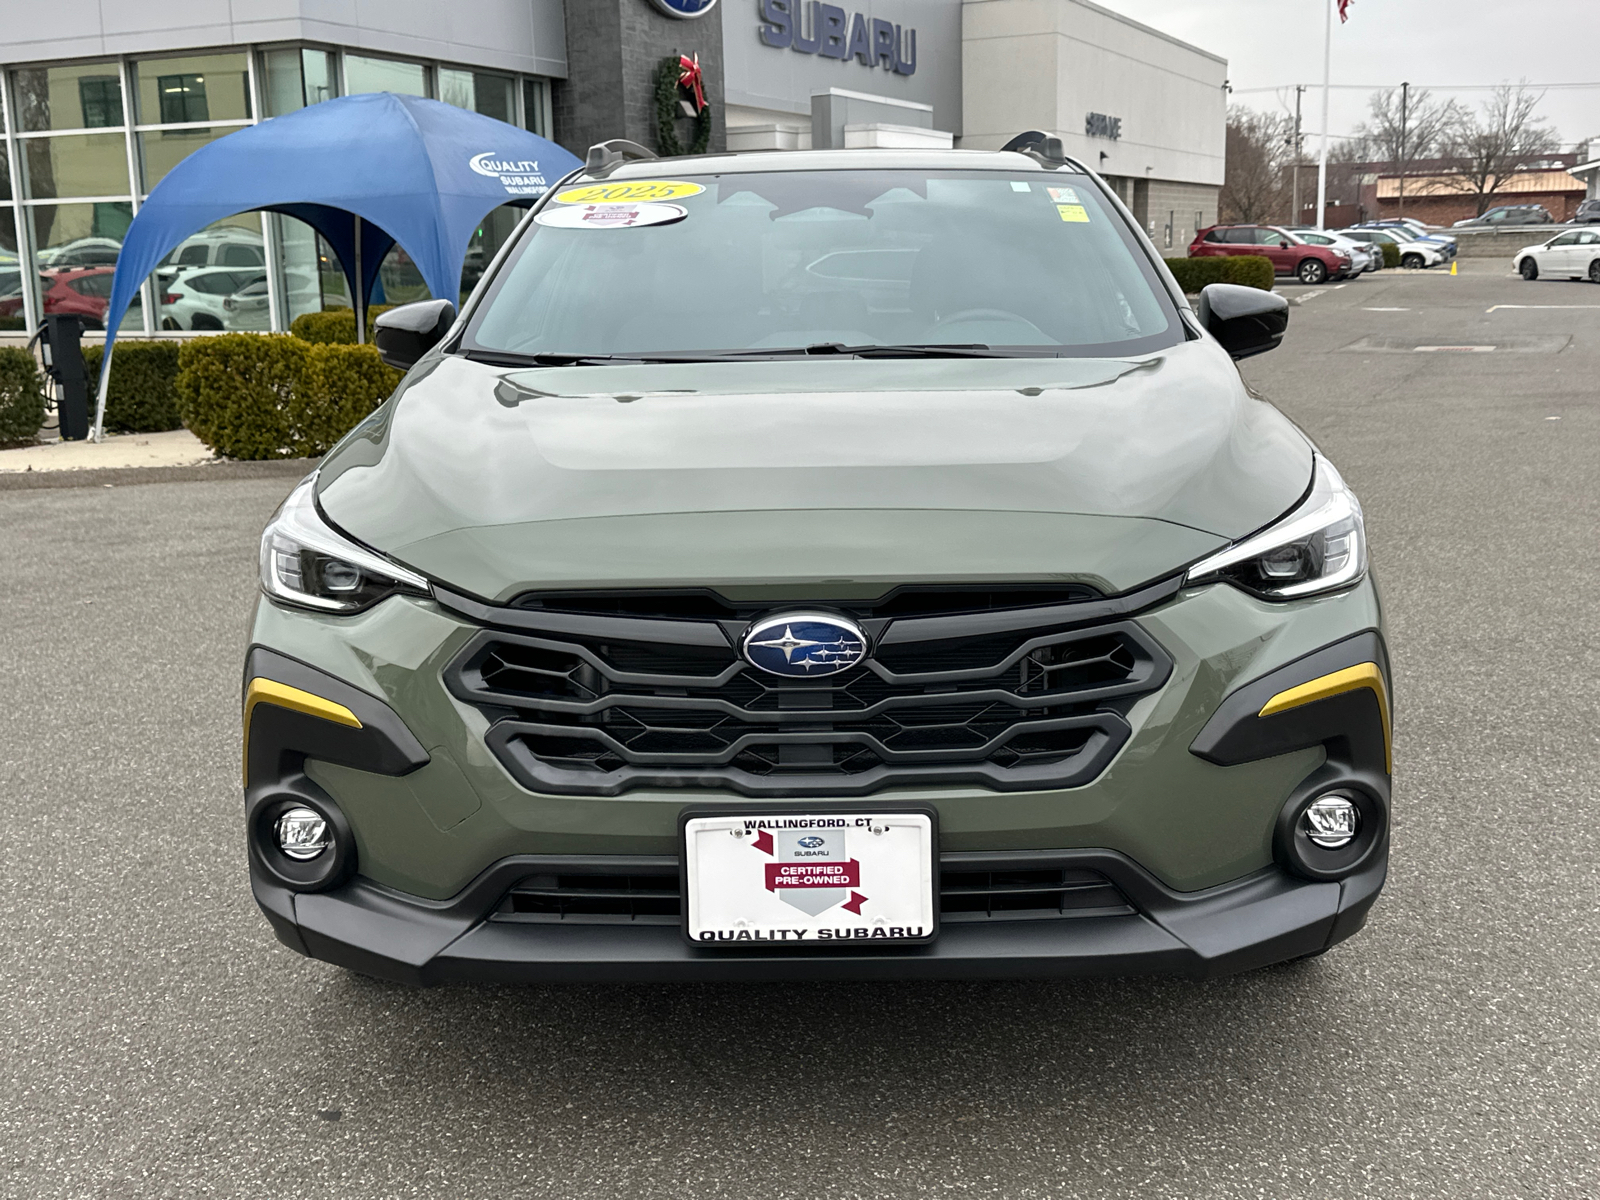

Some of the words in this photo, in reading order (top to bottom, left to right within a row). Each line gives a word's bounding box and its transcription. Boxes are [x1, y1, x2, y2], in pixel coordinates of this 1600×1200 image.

[758, 0, 917, 76] SUBARU
[480, 160, 539, 172] QUALITY
[500, 175, 546, 186] SUBARU
[577, 184, 682, 202] 2025
[855, 817, 873, 828] CT
[780, 865, 844, 876] CERTIFIED
[775, 875, 850, 885] PRE-OWNED
[699, 929, 808, 941] QUALITY
[817, 926, 924, 940] SUBARU
